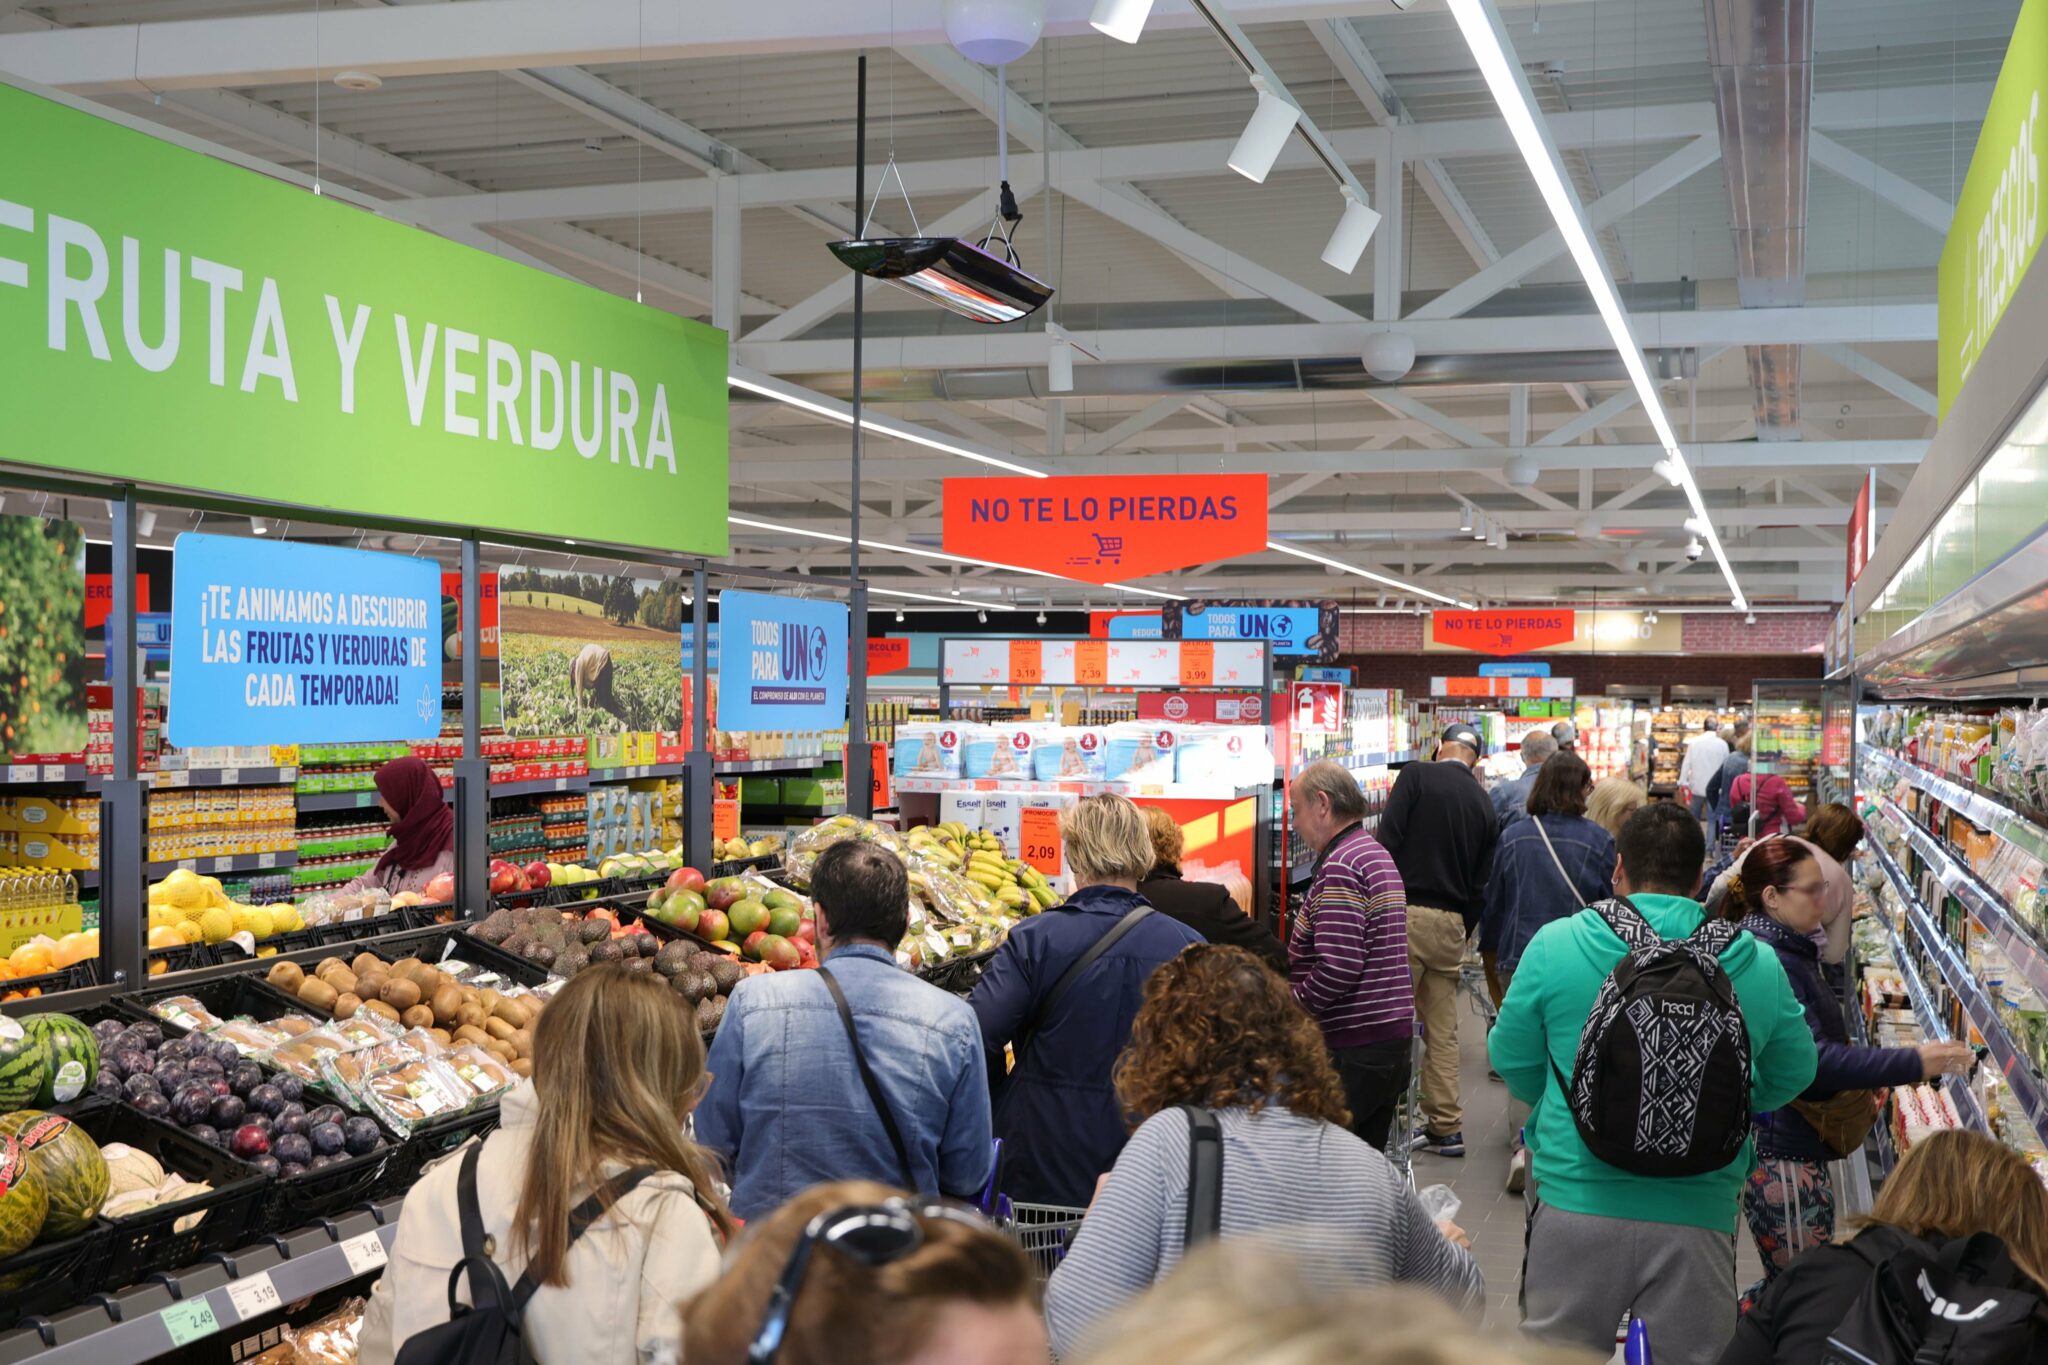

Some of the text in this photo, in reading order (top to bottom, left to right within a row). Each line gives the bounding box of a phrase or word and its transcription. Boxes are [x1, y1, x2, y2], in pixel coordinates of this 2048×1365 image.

[1976, 89, 2040, 351] FRESCOS
[323, 293, 372, 415] Y
[393, 313, 678, 475] VERDURA
[971, 495, 1238, 522] NO TE LO PIERDAS
[201, 584, 428, 630] ¡TE ANIMAMOS A DESCUBRIR
[1207, 614, 1236, 625] TODOS
[1445, 618, 1563, 630] NO TE LO PIERDAS
[752, 620, 779, 646] TODOS
[1208, 625, 1237, 638] PARA
[202, 629, 427, 667] LAS FRUTAS Y VERDURAS DE
[868, 643, 902, 651] RCOLES
[752, 651, 779, 680] PARA
[245, 673, 399, 708] CADA TEMPORADA!
[1027, 845, 1055, 860] 2,09
[362, 1241, 382, 1258] 3,49
[253, 1285, 276, 1303] 3,19
[190, 1309, 214, 1330] 2,49
